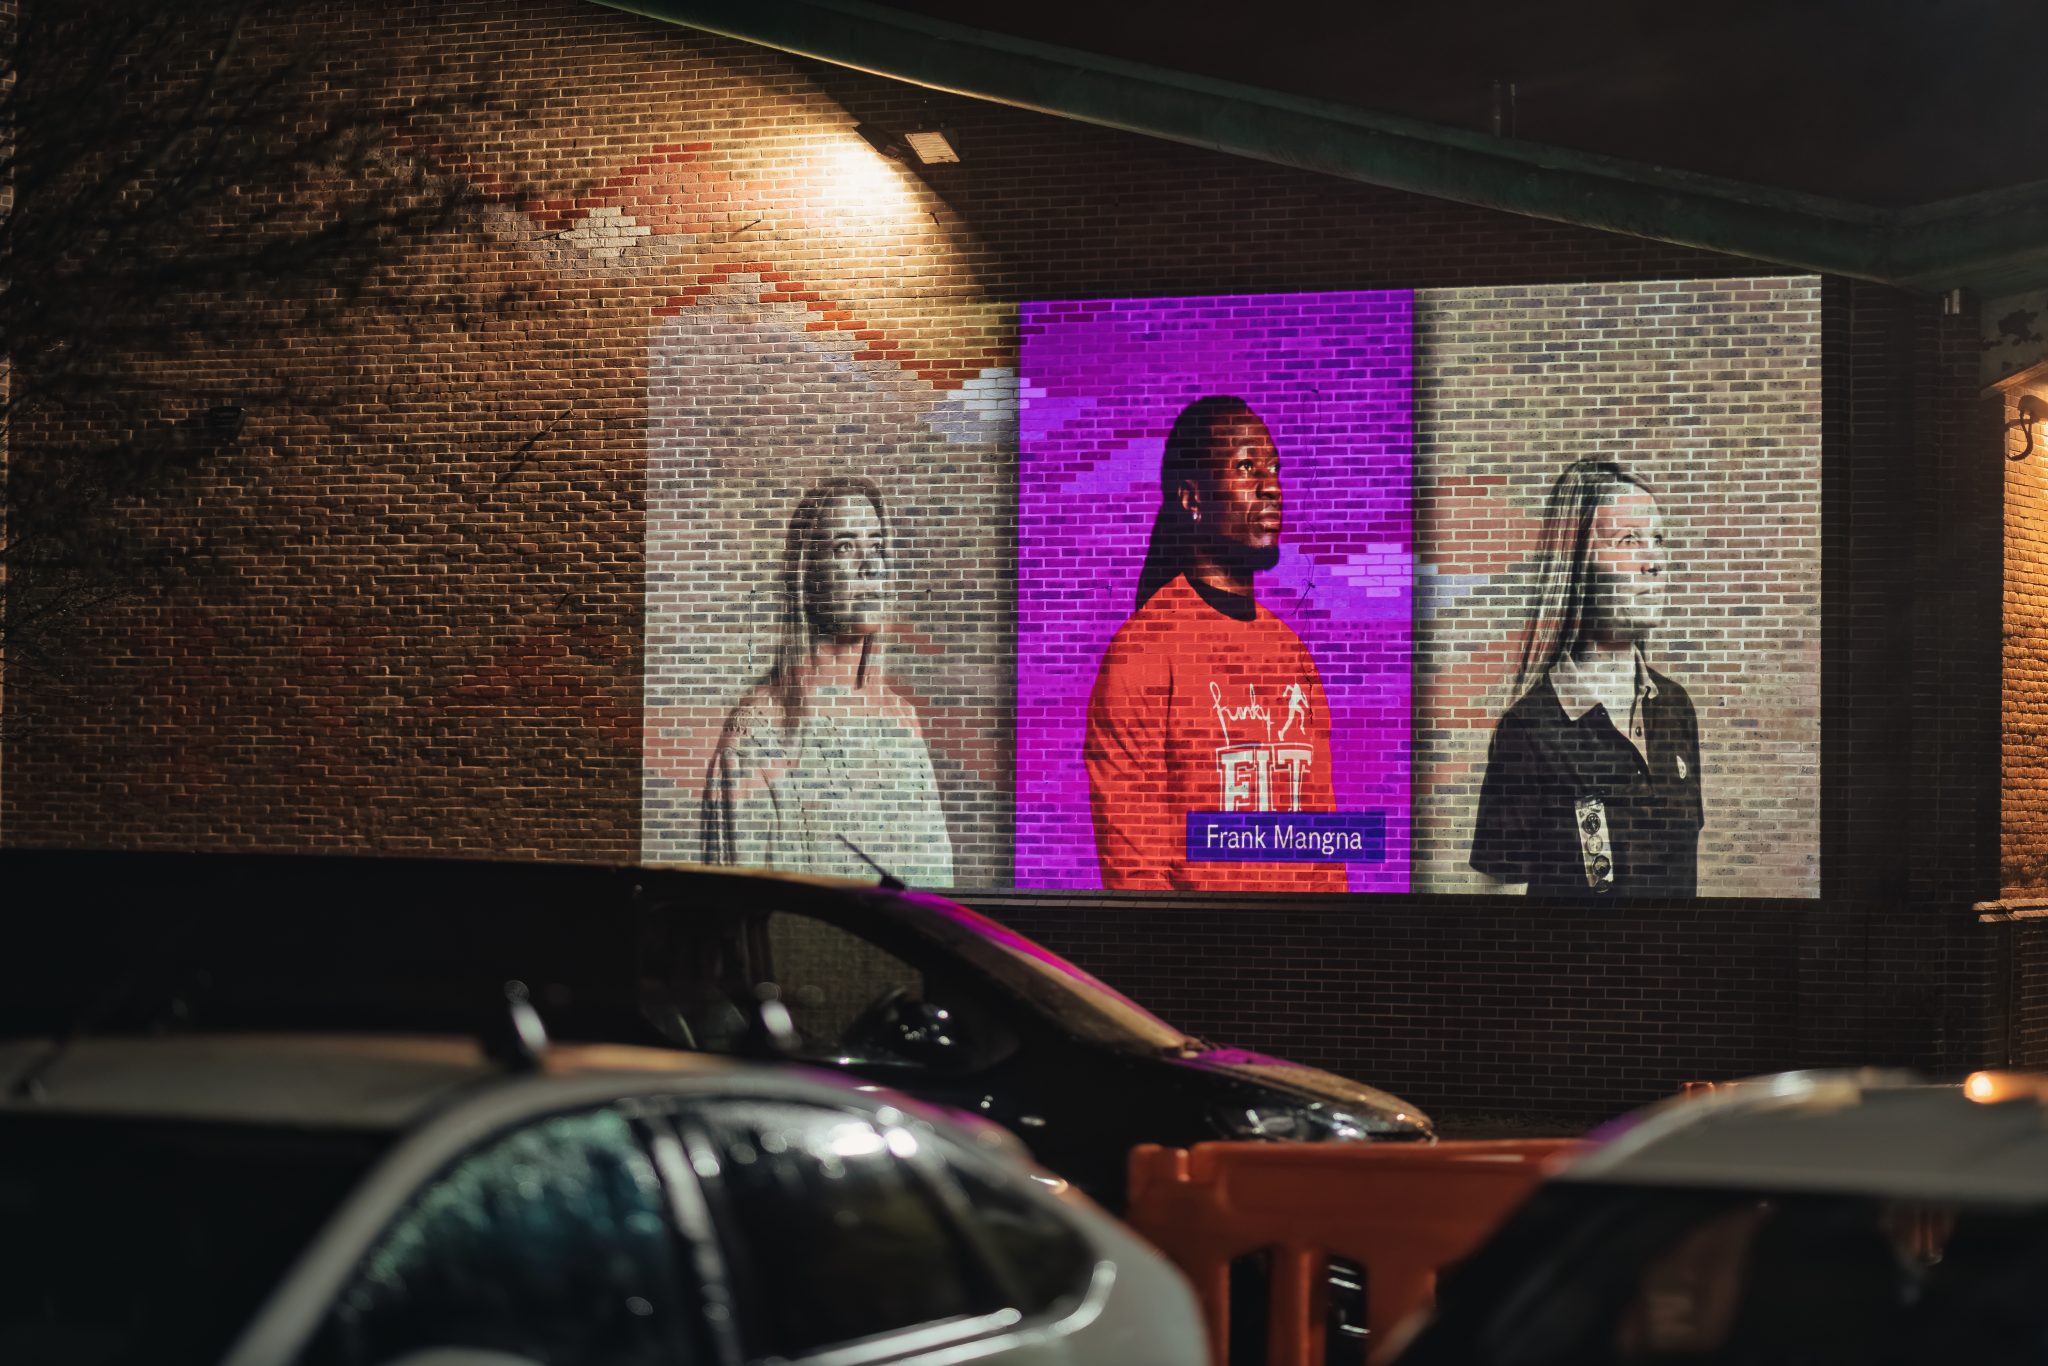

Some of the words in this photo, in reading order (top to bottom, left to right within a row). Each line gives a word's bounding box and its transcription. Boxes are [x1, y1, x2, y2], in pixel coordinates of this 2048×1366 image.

[1216, 744, 1314, 812] FIT
[1206, 824, 1267, 849] Frank
[1274, 824, 1363, 855] Mangna
